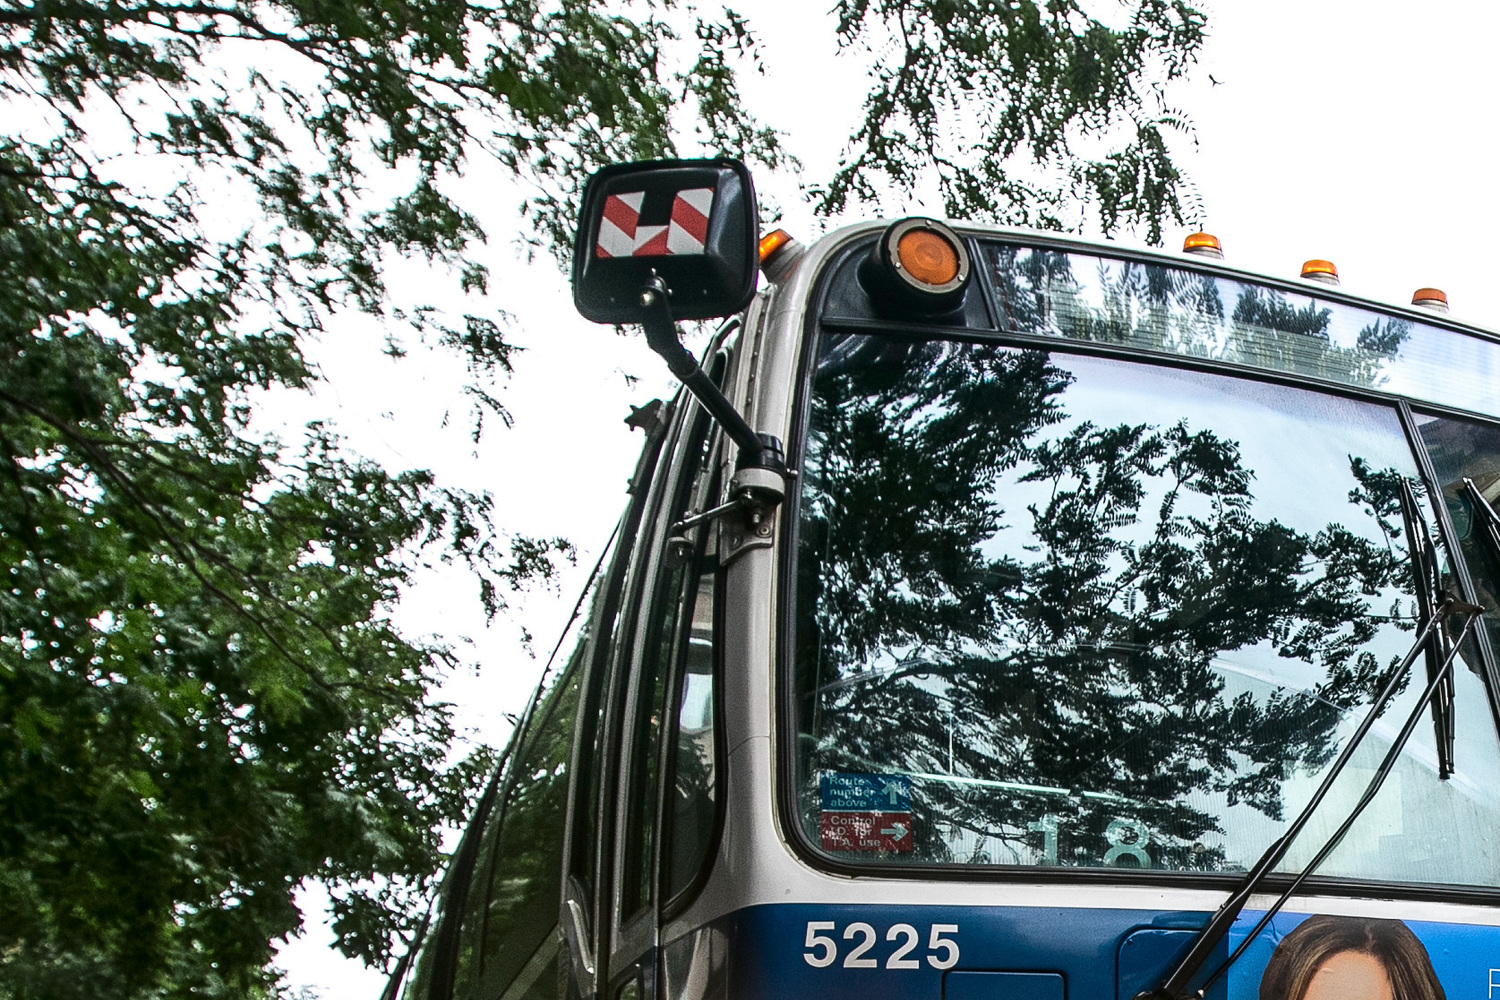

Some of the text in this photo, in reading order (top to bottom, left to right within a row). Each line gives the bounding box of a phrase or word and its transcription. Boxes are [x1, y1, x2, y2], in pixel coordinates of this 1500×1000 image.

[830, 799, 867, 808] above
[830, 816, 876, 825] Control
[803, 921, 960, 970] 5225
